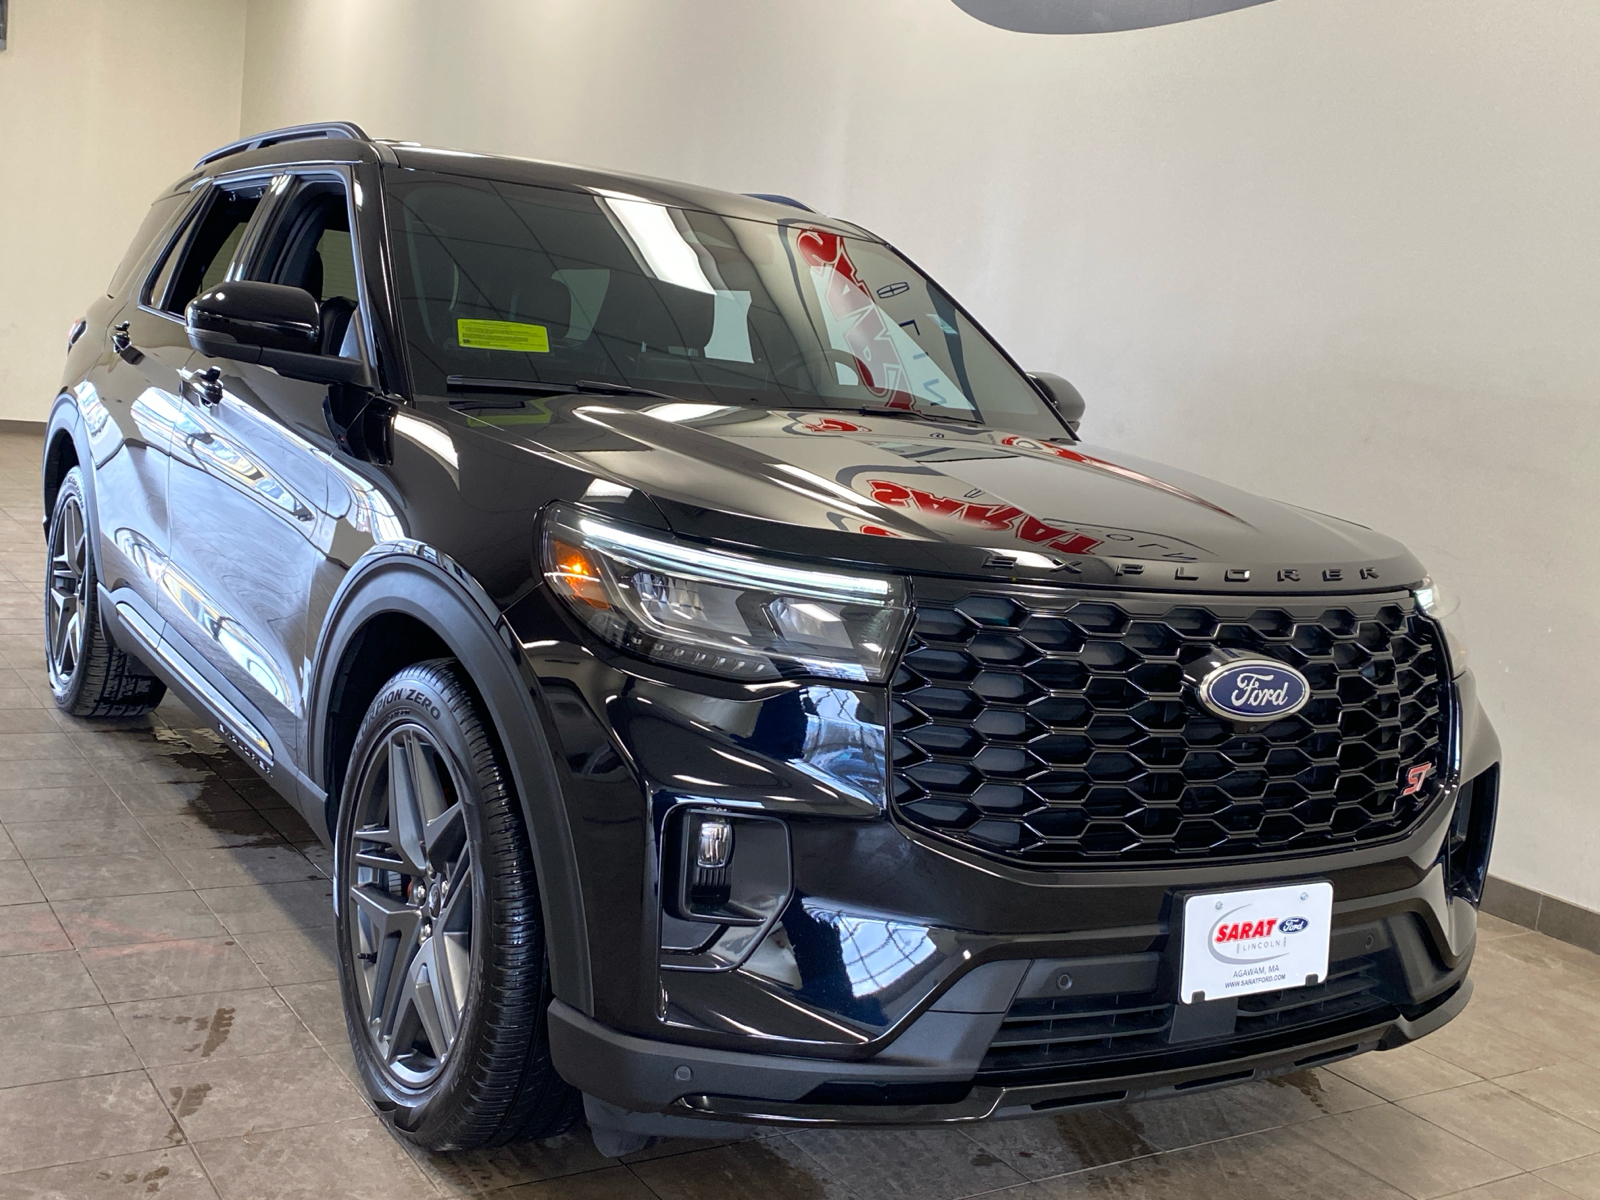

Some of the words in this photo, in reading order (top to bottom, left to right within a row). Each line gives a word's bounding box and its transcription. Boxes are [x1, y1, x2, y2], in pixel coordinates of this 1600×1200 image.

[981, 554, 1380, 583] EXPLORER
[1231, 672, 1289, 706] Ford
[405, 688, 441, 721] ZERO
[1403, 762, 1432, 796] ST
[1215, 918, 1279, 942] SARAT
[1283, 919, 1303, 932] Ford
[1243, 940, 1280, 951] LINCOLN
[1225, 974, 1286, 988] WWW.SARATFORD.COM
[1233, 967, 1267, 978] AGAWAM,
